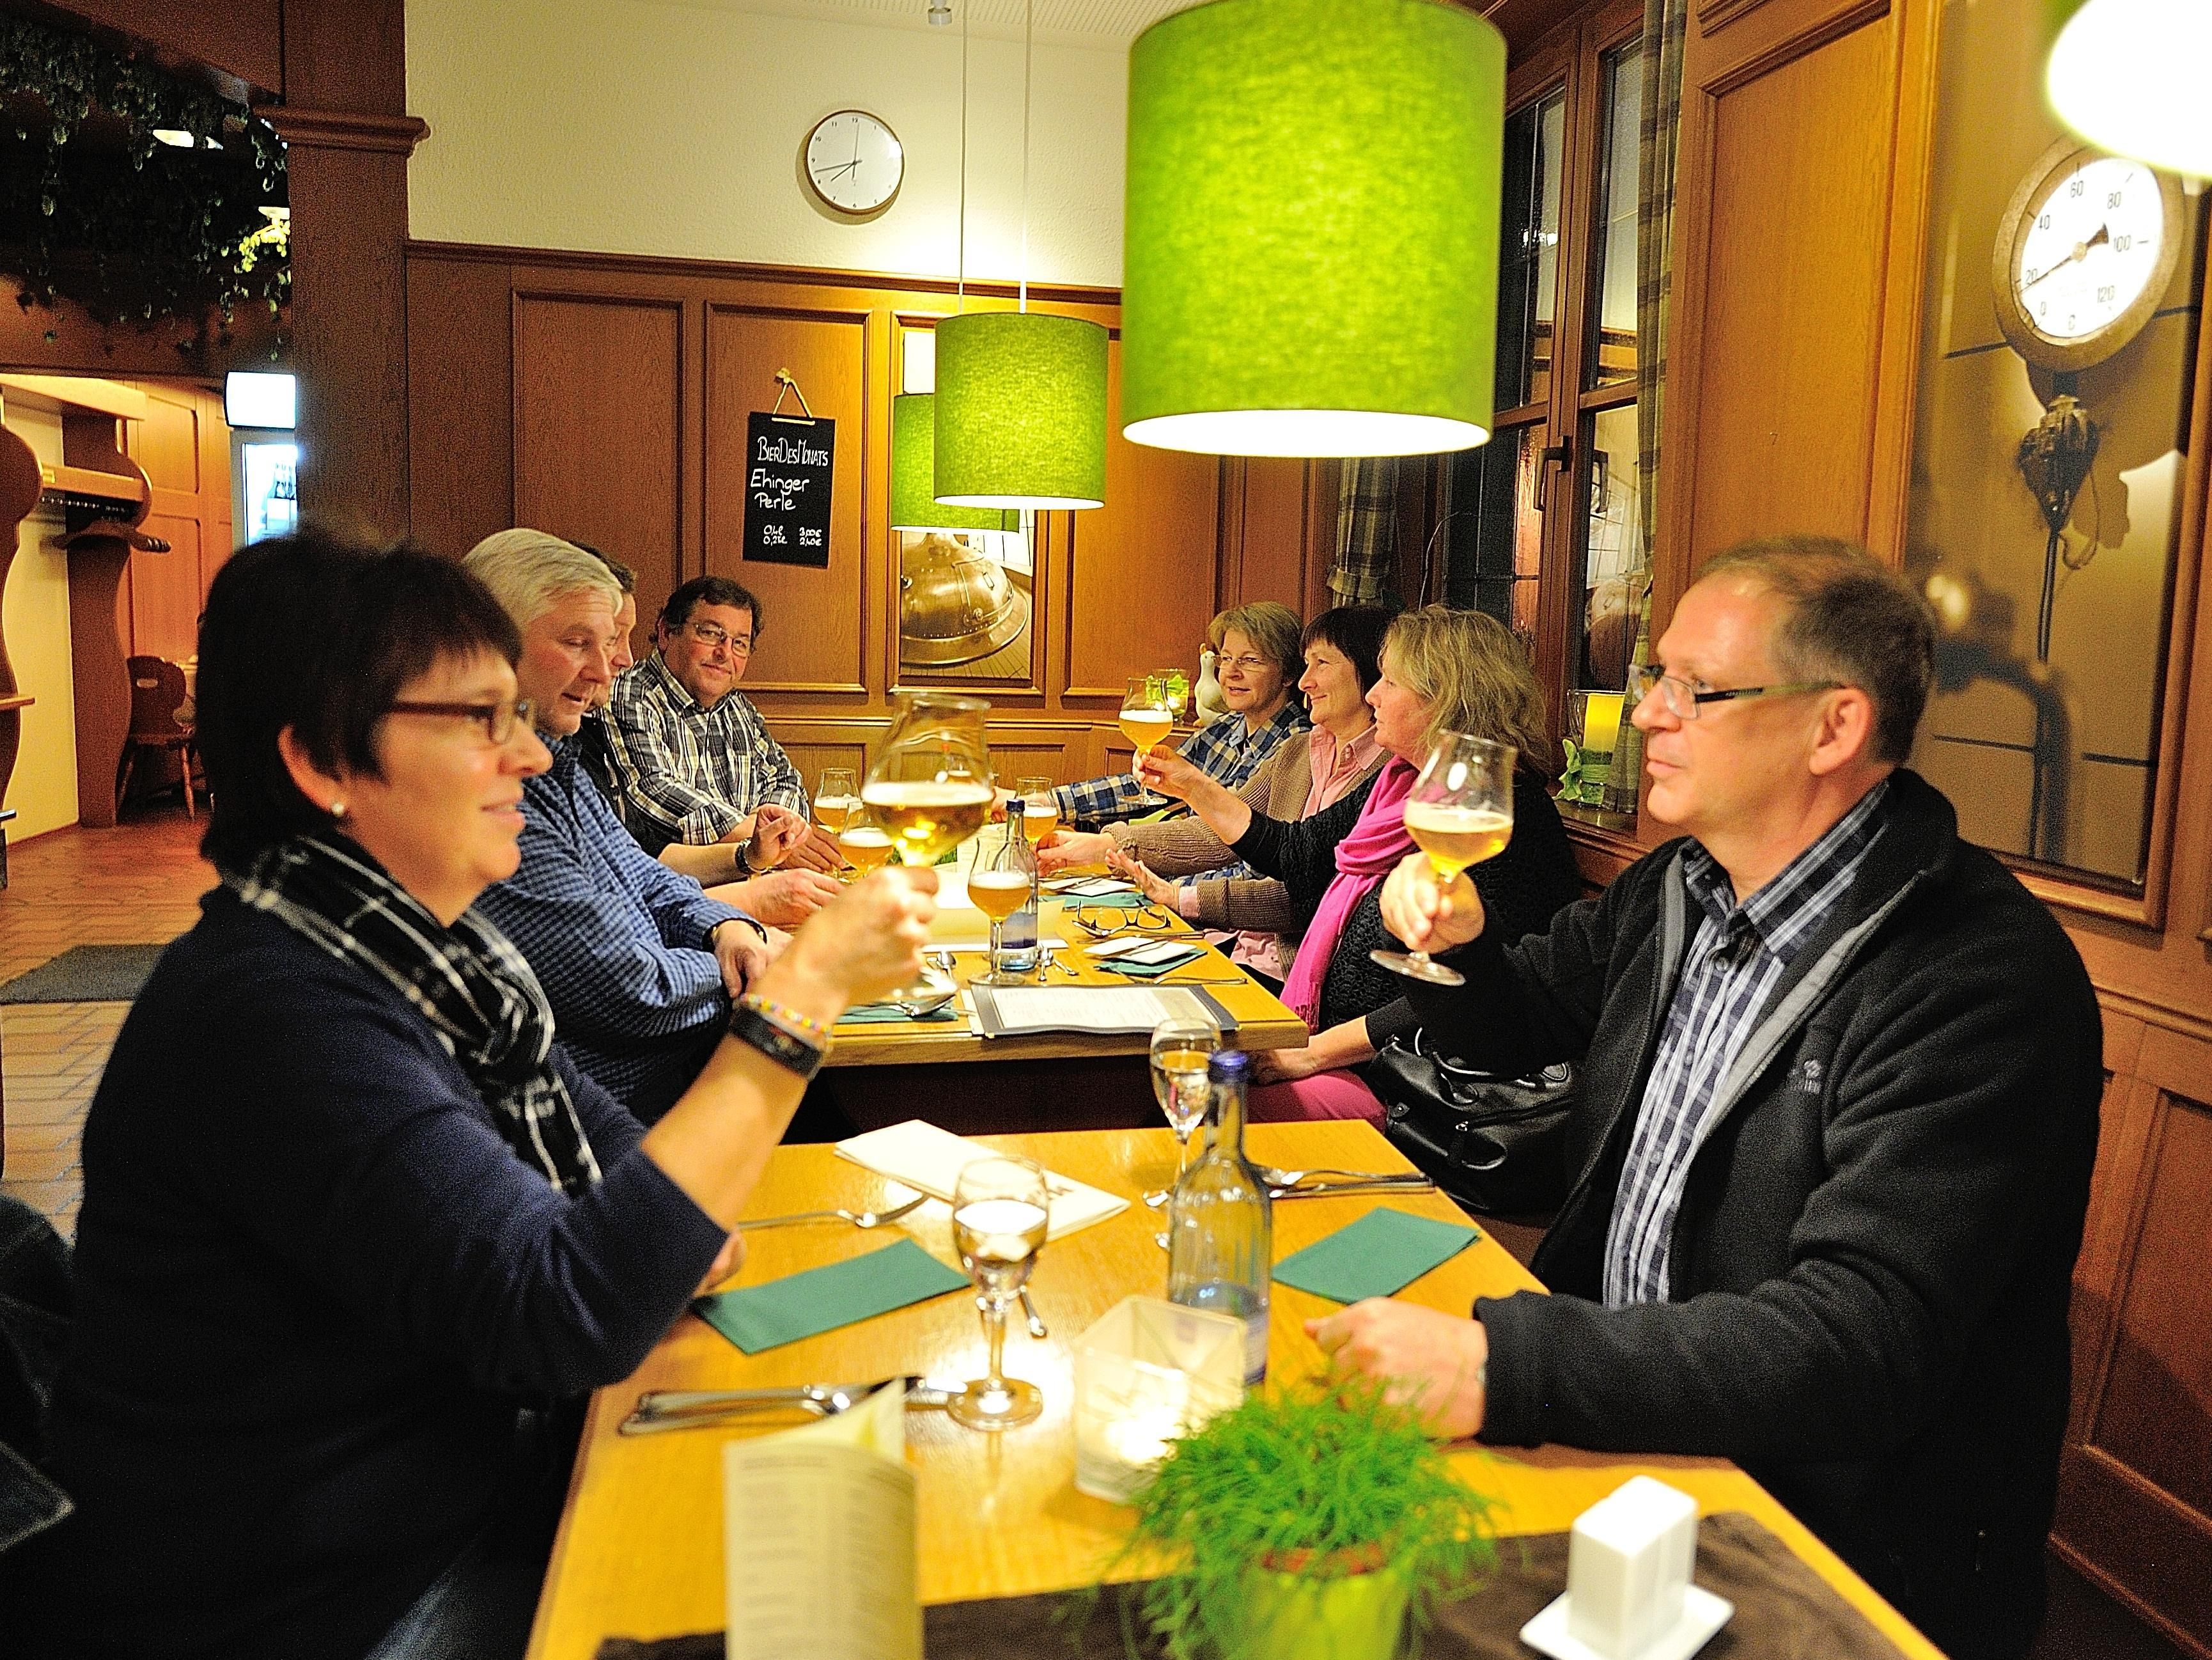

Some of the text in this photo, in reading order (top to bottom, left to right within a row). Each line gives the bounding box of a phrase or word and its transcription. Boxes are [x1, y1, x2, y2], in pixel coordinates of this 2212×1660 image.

[2070, 180, 2084, 198] 60
[2107, 191, 2122, 209] 80
[2113, 235, 2131, 252] 100
[2025, 268, 2038, 285] 20
[2097, 285, 2115, 303] 120
[2040, 301, 2046, 316] 0
[750, 468, 810, 496] Ehinger
[754, 492, 797, 511] Perle
